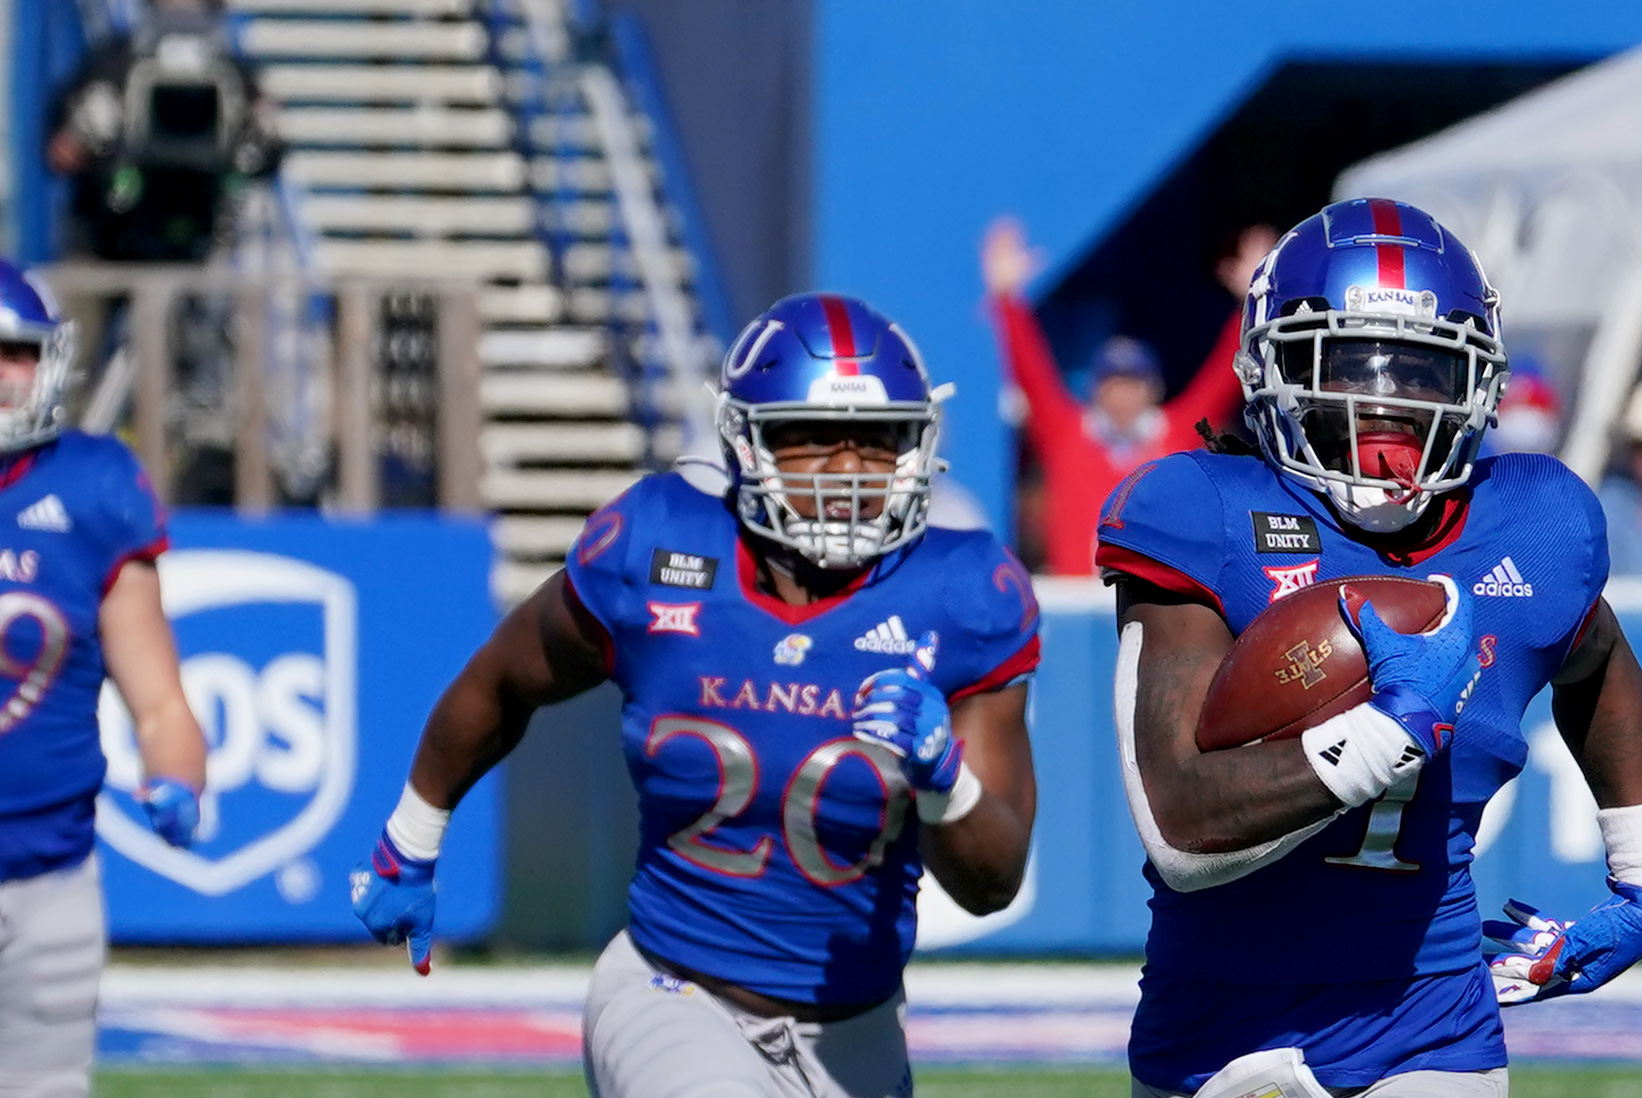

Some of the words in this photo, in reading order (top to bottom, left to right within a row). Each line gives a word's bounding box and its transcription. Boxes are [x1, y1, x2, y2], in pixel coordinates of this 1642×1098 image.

[1368, 291, 1414, 305] KANSAS
[830, 382, 867, 393] KANSAS
[1266, 515, 1300, 531] BLM
[1265, 533, 1311, 549] UNITY
[668, 552, 704, 570] BLM
[659, 568, 708, 586] UNITY
[1473, 582, 1534, 597] adidas
[854, 636, 916, 655] adidas
[698, 676, 849, 720] KANSA
[645, 714, 914, 888] 20
